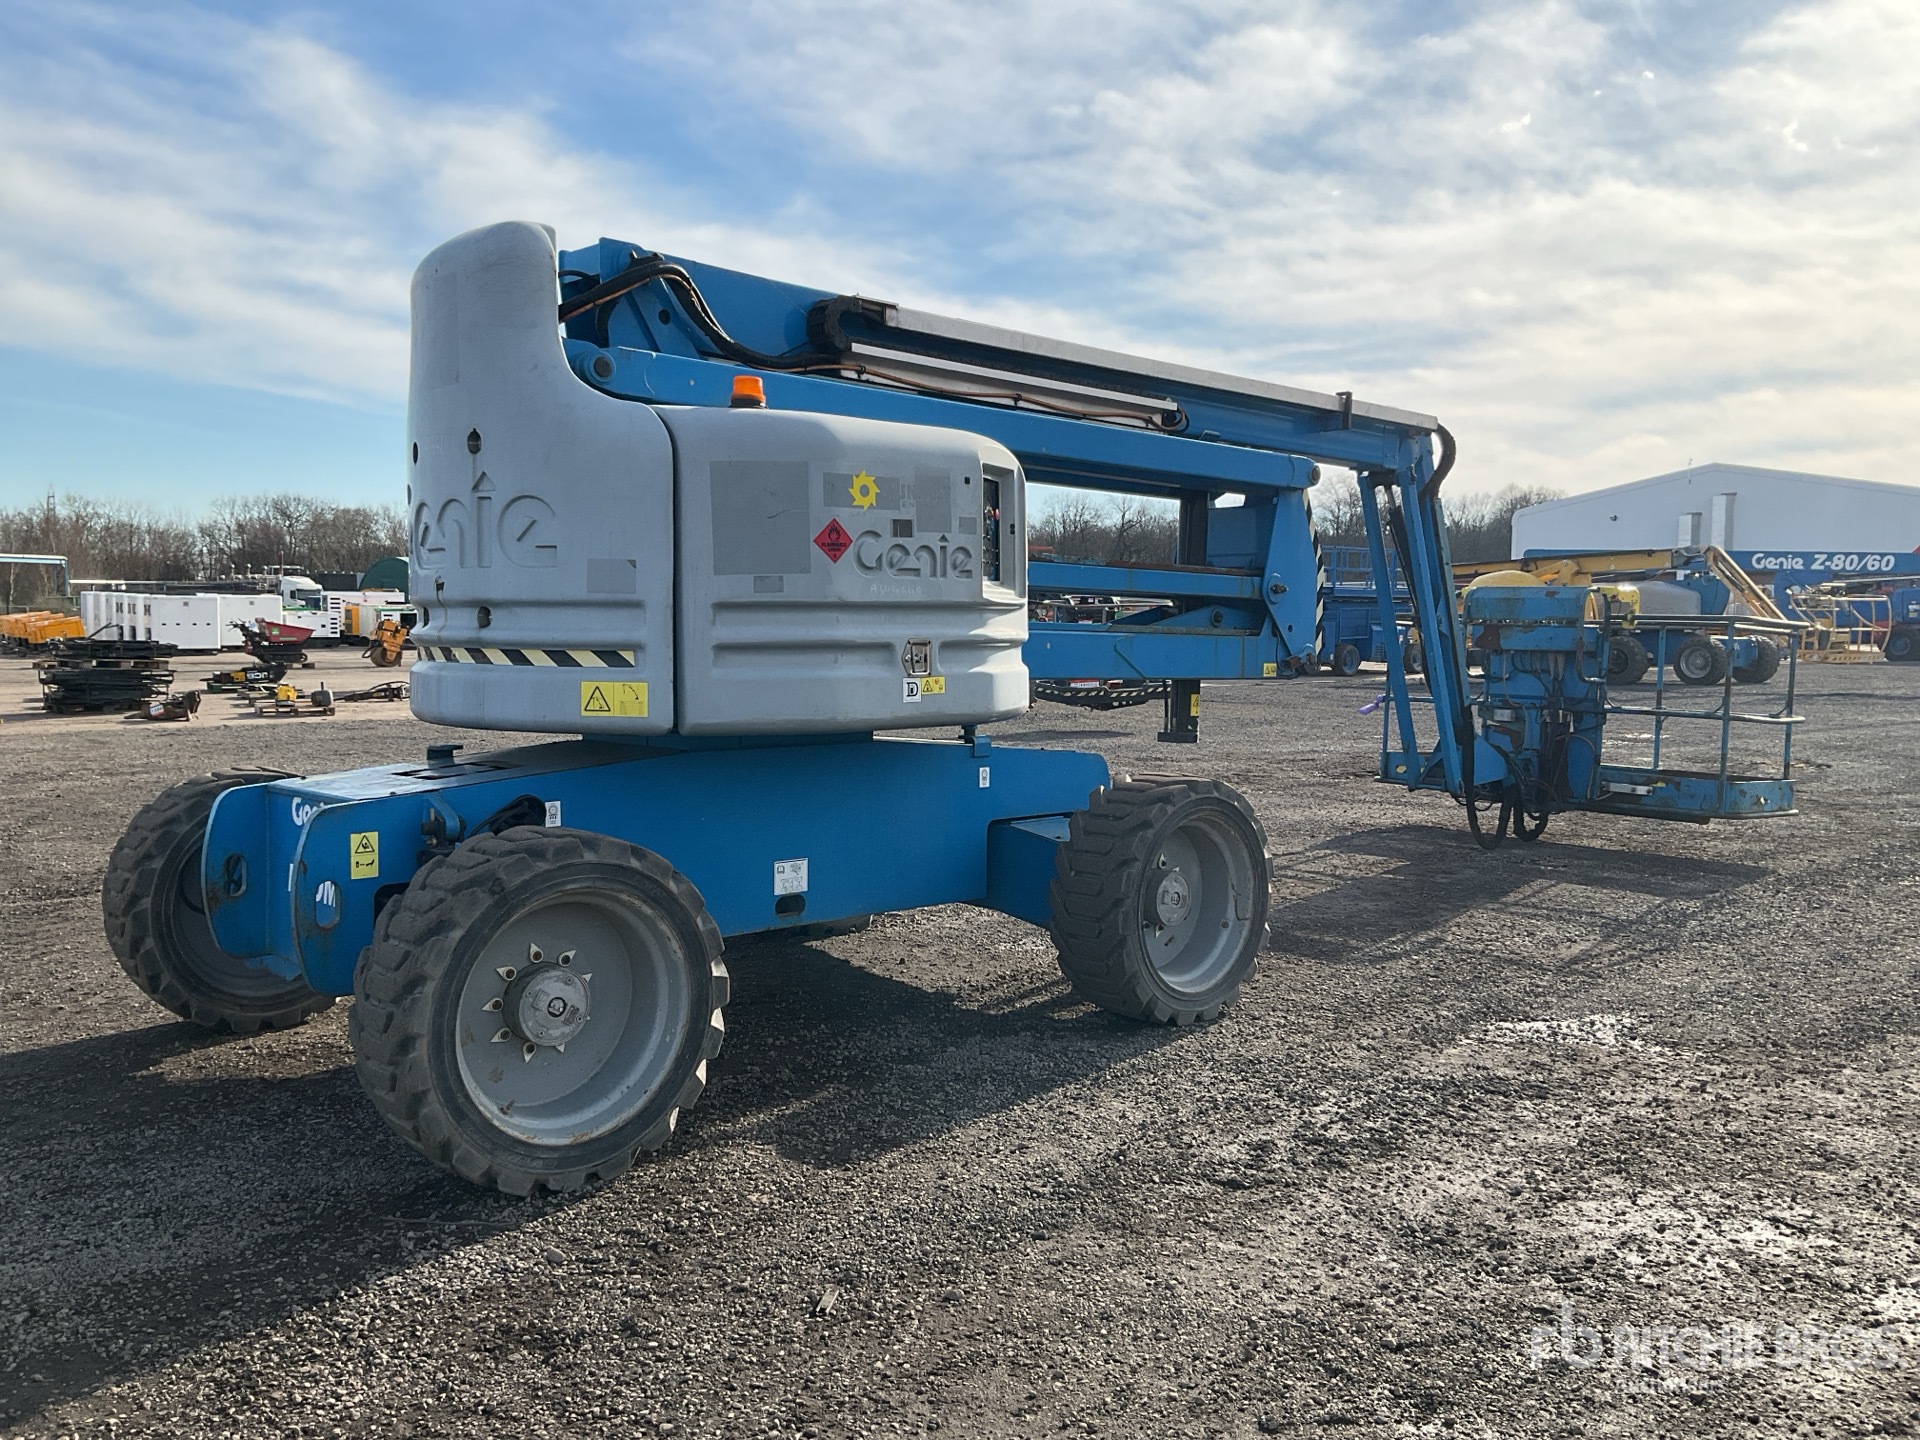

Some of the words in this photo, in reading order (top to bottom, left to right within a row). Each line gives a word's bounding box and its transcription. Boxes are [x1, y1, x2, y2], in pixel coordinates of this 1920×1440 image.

[409, 471, 558, 570] enie
[853, 530, 974, 579] Genie
[1751, 552, 1805, 570] Genie
[1810, 553, 1896, 572] Z-80/60
